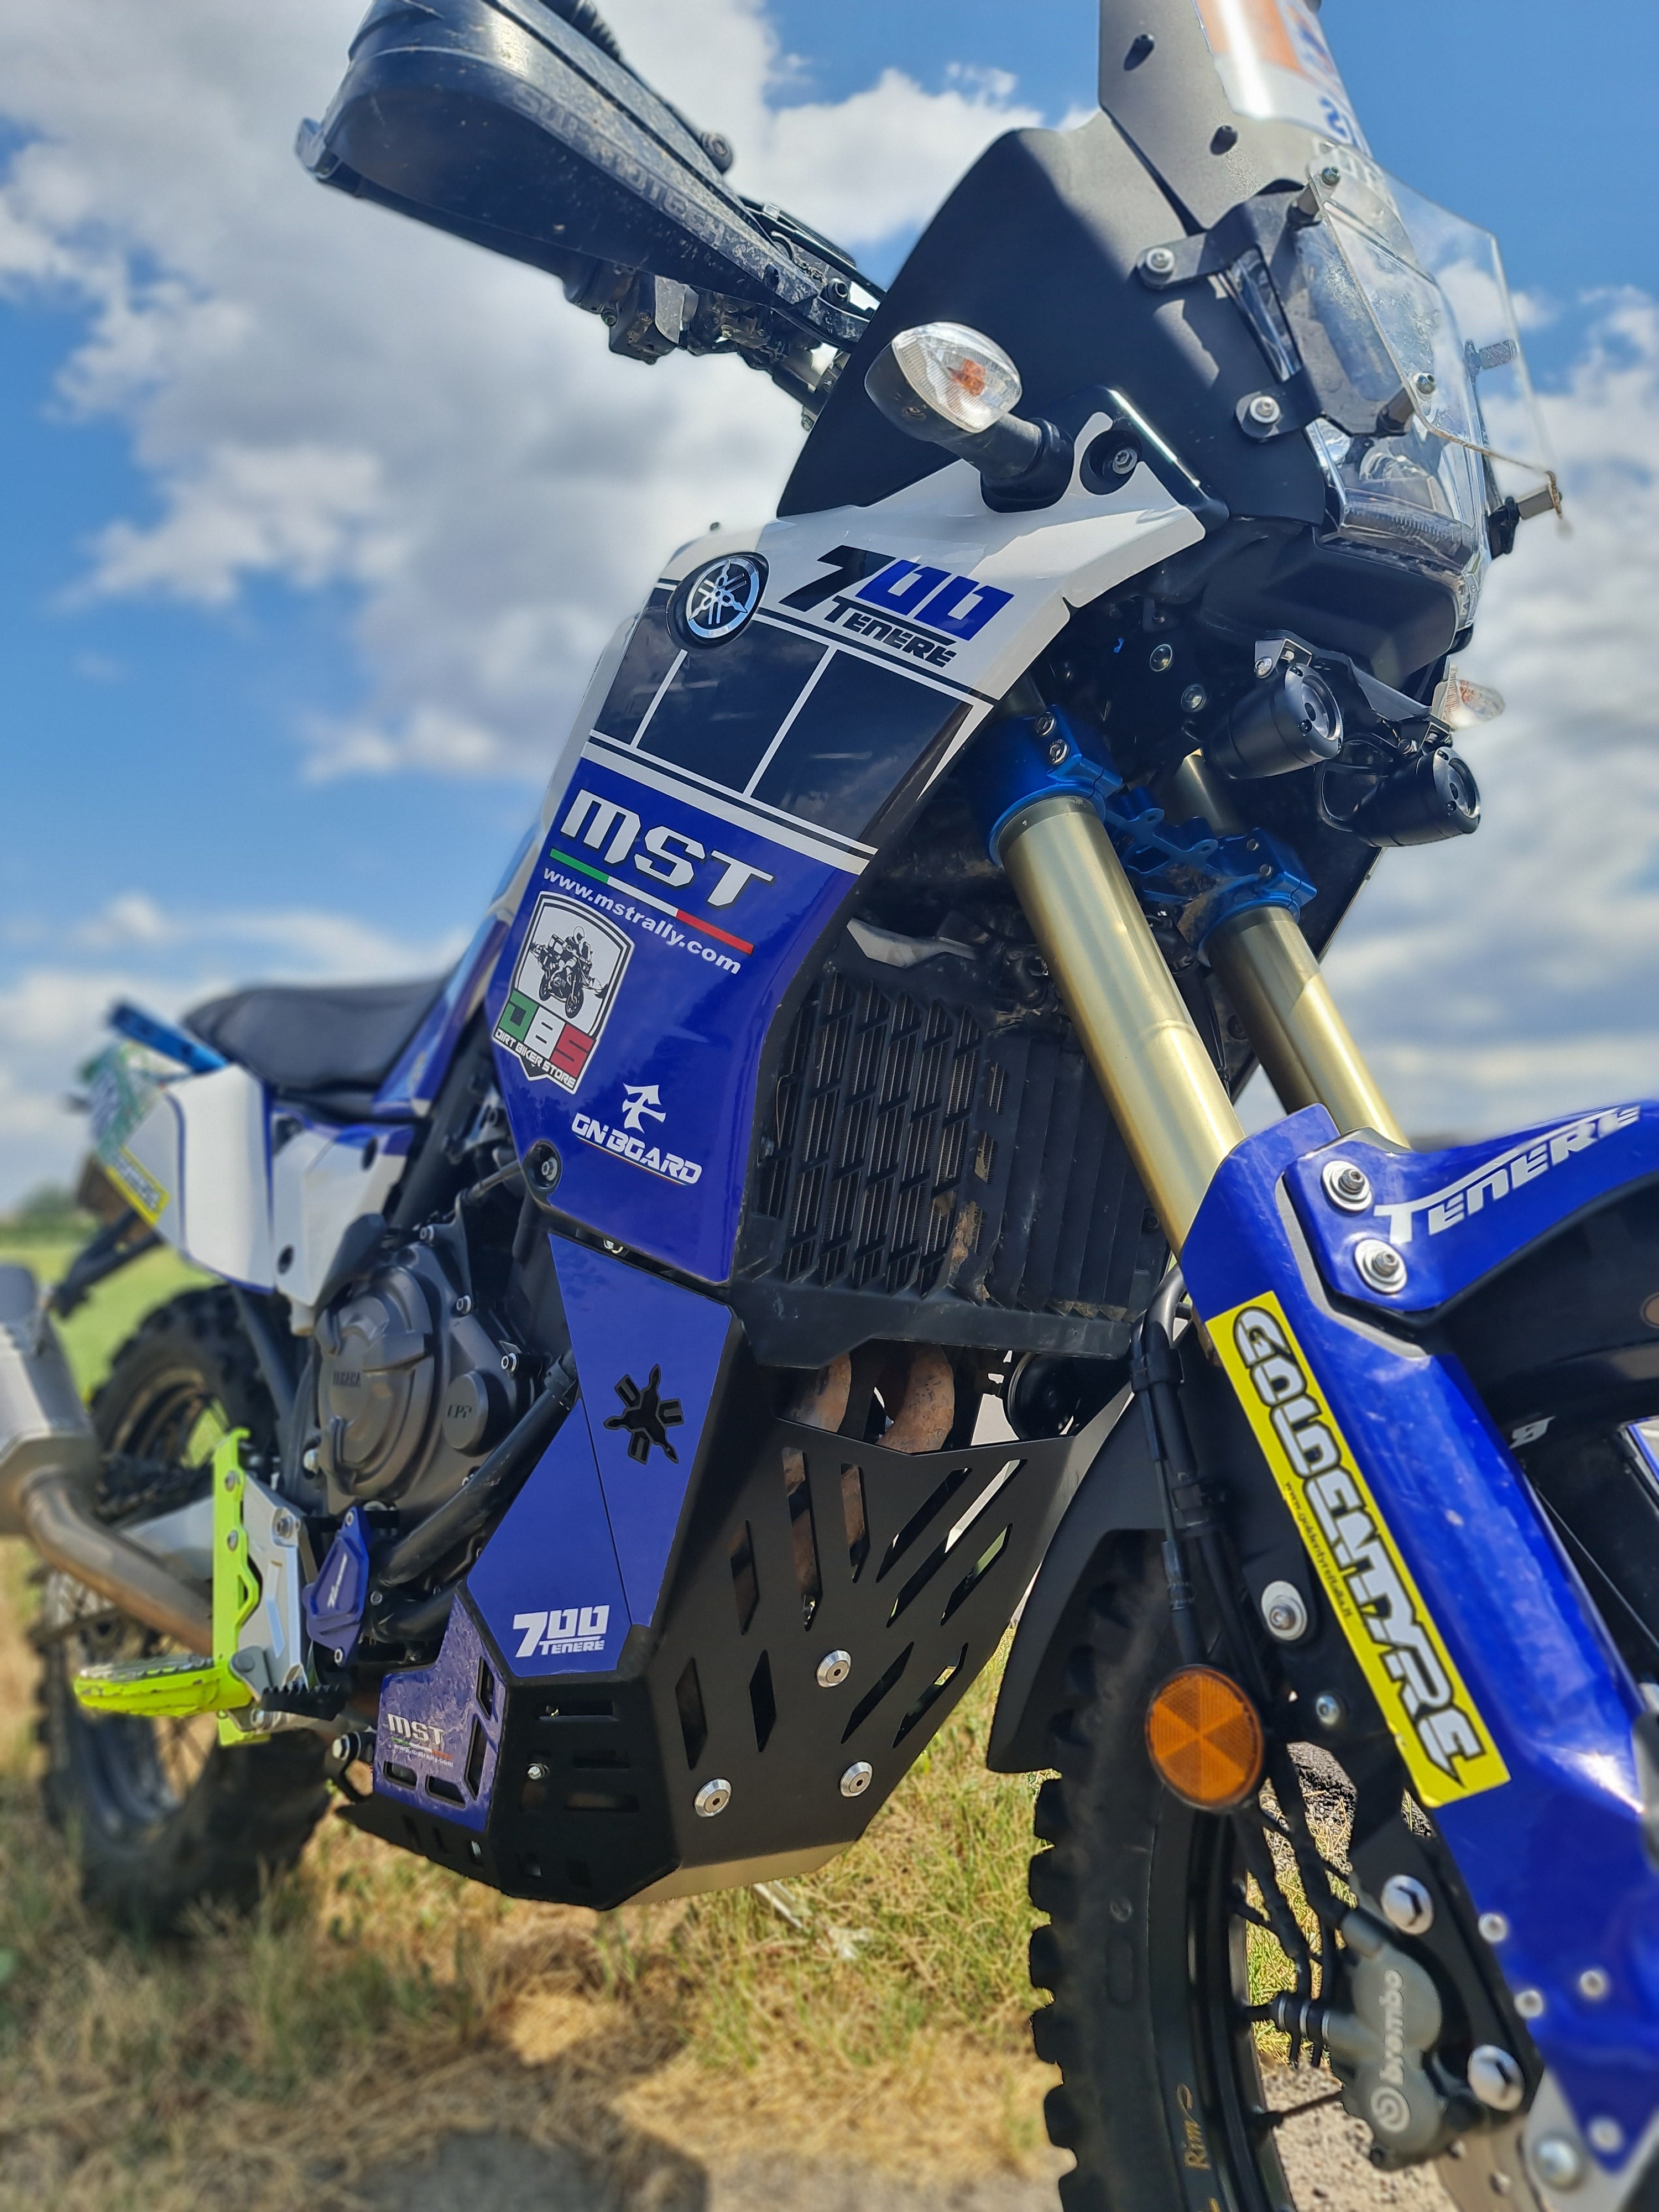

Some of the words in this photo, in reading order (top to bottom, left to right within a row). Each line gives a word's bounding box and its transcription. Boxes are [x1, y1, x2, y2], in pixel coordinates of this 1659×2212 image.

[778, 545, 1015, 641] 700
[824, 595, 957, 667] TENERE
[560, 789, 774, 906] MST
[543, 868, 741, 974] www.mstrally.com
[495, 1028, 516, 1047] DIRT
[515, 1042, 544, 1067] BIKER
[542, 1061, 576, 1088] STORE
[498, 989, 594, 1078] DBS
[1373, 1105, 1640, 1244] TENERE
[1233, 1306, 1486, 1787] GOLDENTYRE
[513, 1605, 610, 1658] 700
[539, 1636, 605, 1655] TENERE
[388, 1713, 444, 1744] MST
[1379, 1969, 1404, 2086] brembo
